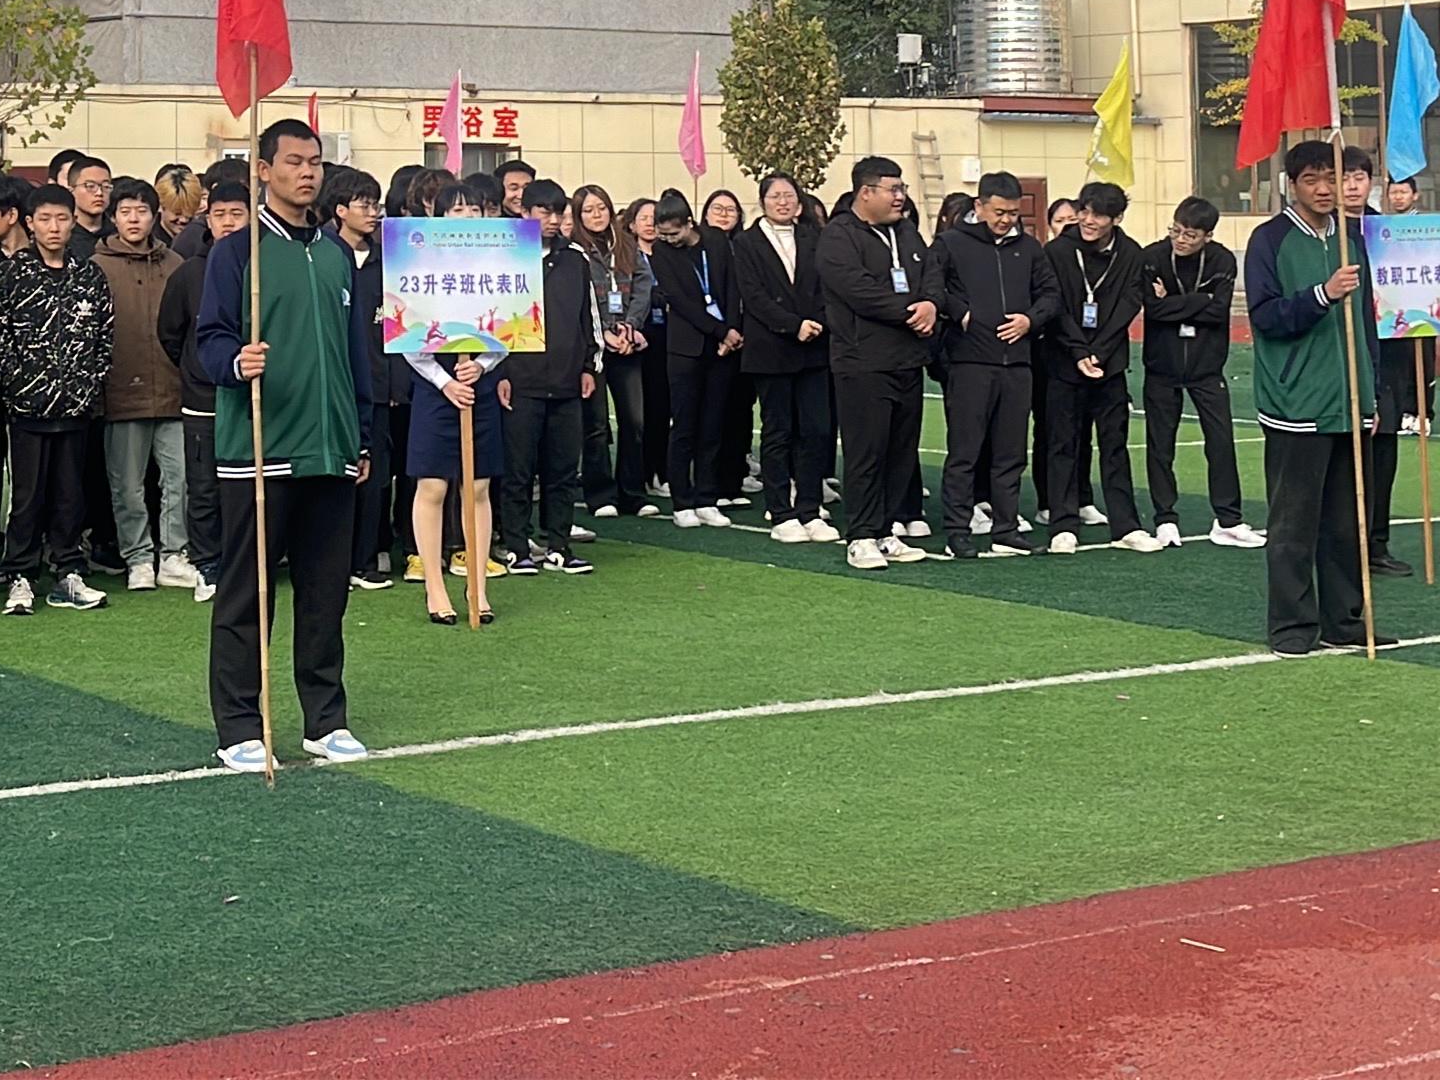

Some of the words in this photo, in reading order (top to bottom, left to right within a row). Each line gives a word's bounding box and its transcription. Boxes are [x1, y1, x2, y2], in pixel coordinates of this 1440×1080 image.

[399, 273, 529, 295] 23升学班代表队
